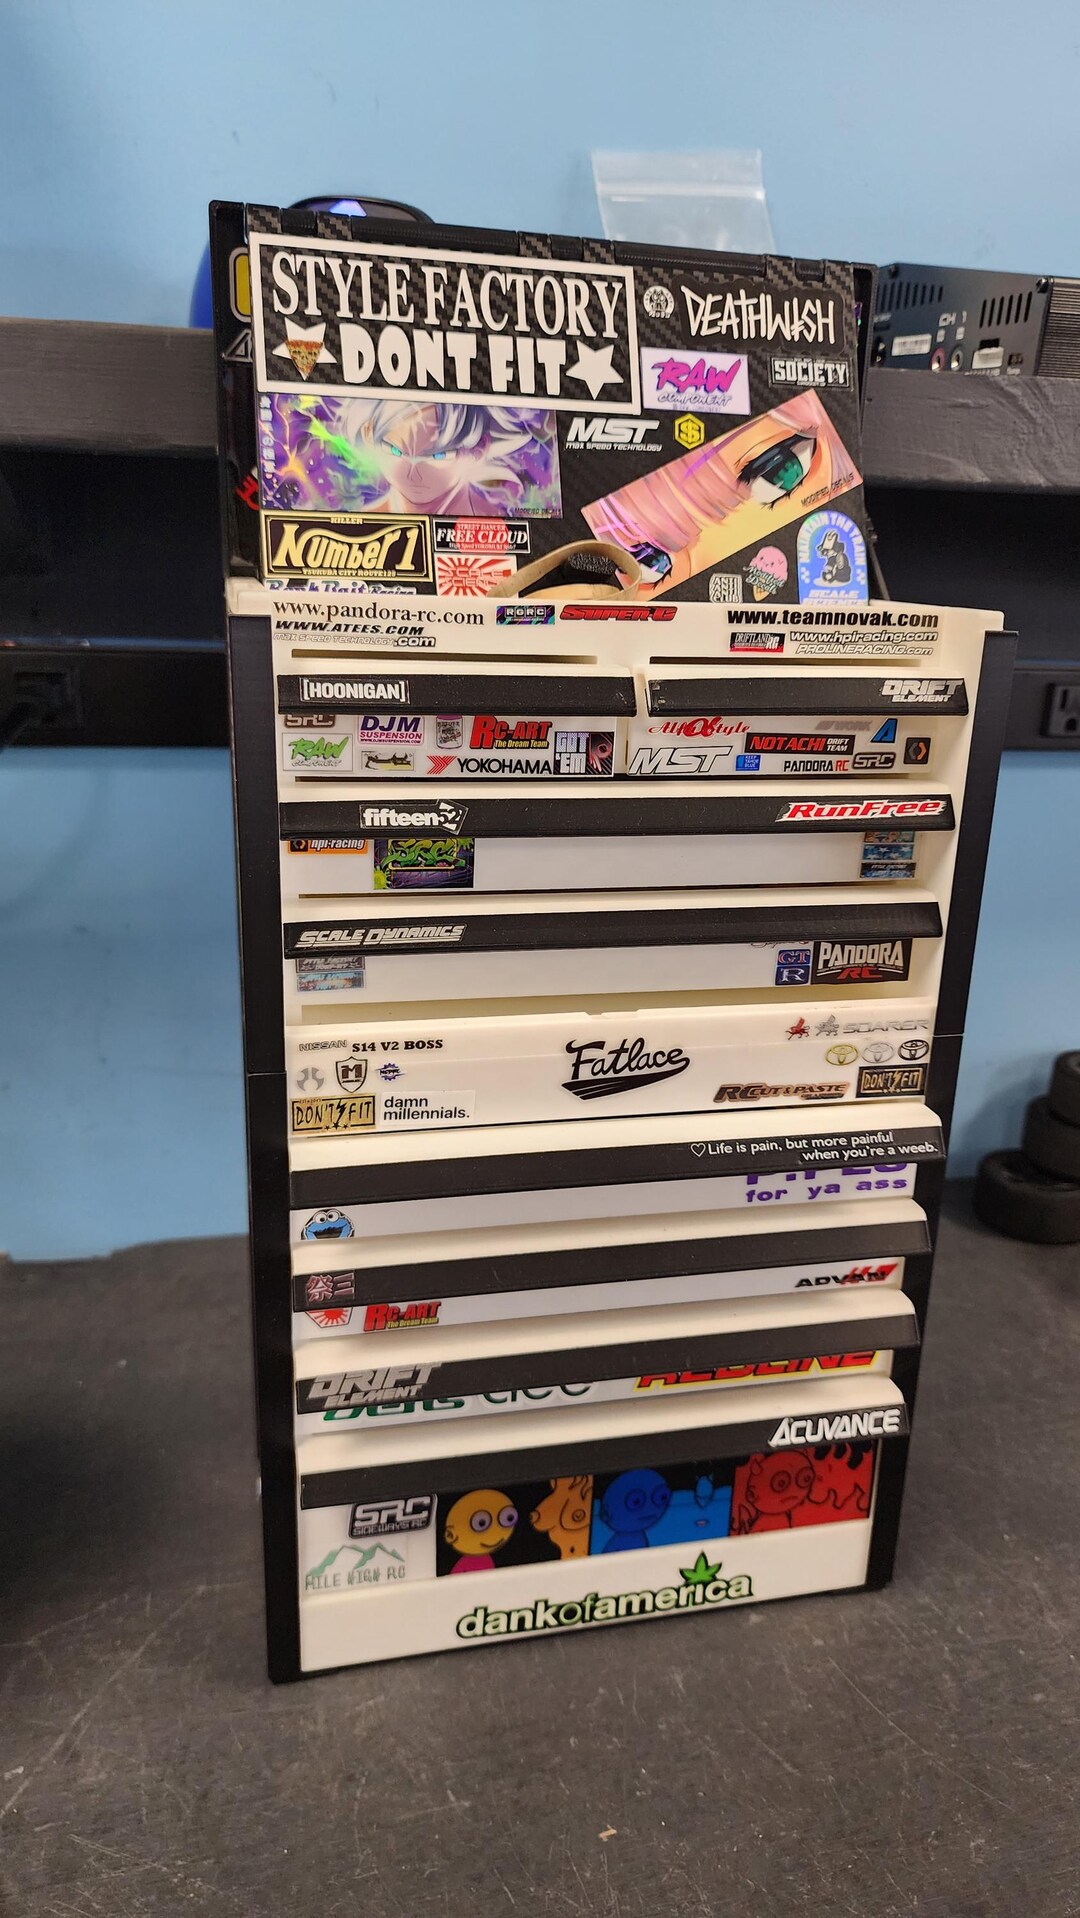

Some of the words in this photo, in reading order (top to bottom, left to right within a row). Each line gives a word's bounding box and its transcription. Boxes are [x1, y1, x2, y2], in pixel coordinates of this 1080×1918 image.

[272, 251, 414, 323] STYLE
[421, 265, 623, 339] FACTORY
[681, 285, 835, 345] DEATHWISH
[340, 322, 477, 391] DONT
[488, 333, 566, 396] FIT
[651, 357, 742, 394] RAW
[774, 360, 847, 385] SOCIETY
[566, 417, 660, 443] MST
[330, 517, 364, 525] KILLER
[437, 528, 475, 543] FREE
[478, 530, 528, 544] CLOUD
[274, 601, 484, 627] www.pandora-rc.com
[506, 608, 546, 616] RGRC
[727, 609, 939, 628] www.teamnovak.com
[275, 620, 425, 636] WWW.ATEES.COM
[789, 630, 939, 645] www.hpiracing.com
[795, 643, 934, 656] PROLINERACING.com
[882, 679, 964, 696] DRIFT
[891, 694, 951, 703] ELEMENT
[360, 716, 421, 732] DJM
[360, 731, 423, 740] SUSPENSION
[494, 739, 508, 748] The
[508, 740, 530, 748] Dream
[530, 740, 548, 748] Team
[556, 732, 590, 753] GOT
[751, 736, 826, 752] NOTACHI
[288, 736, 350, 761] RAW
[457, 758, 553, 774] YOKOHAMA
[627, 746, 734, 775] MST
[784, 760, 833, 773] PANDORA
[834, 760, 850, 772] RC
[854, 754, 894, 769] SRC
[295, 930, 367, 948] SCALE
[363, 925, 466, 946] DYNAMICS
[817, 941, 904, 969] PANDORA
[837, 966, 883, 980] RC
[843, 1020, 930, 1034] SOARER
[299, 1040, 348, 1052] NISSAN
[352, 1042, 376, 1053] S14
[380, 1041, 400, 1051] V2
[403, 1039, 444, 1050] BOSS
[565, 1037, 684, 1080] Fatlace
[901, 1072, 920, 1087] FIT
[384, 1096, 429, 1109] damn
[296, 1103, 335, 1126] DON'T
[348, 1101, 372, 1122] FIT
[383, 1107, 470, 1121] millennials.
[708, 1142, 733, 1156] Life
[736, 1141, 747, 1153] is
[751, 1141, 783, 1155] pain,
[785, 1138, 808, 1149] but
[811, 1137, 847, 1148] more
[851, 1132, 894, 1148] painful
[802, 1149, 839, 1161] when
[842, 1146, 885, 1161] you're
[898, 1142, 938, 1154] weeb.
[746, 1189, 788, 1203] for
[808, 1183, 841, 1199] ya
[856, 1179, 907, 1191] ass
[795, 1271, 888, 1288] ADVAN
[308, 1361, 443, 1400] DRIFT
[767, 1409, 901, 1448] ACUVANCE
[355, 1496, 431, 1527] SRC
[352, 1520, 410, 1536] SIDEWAYS
[457, 1575, 752, 1638] dankofamerica
